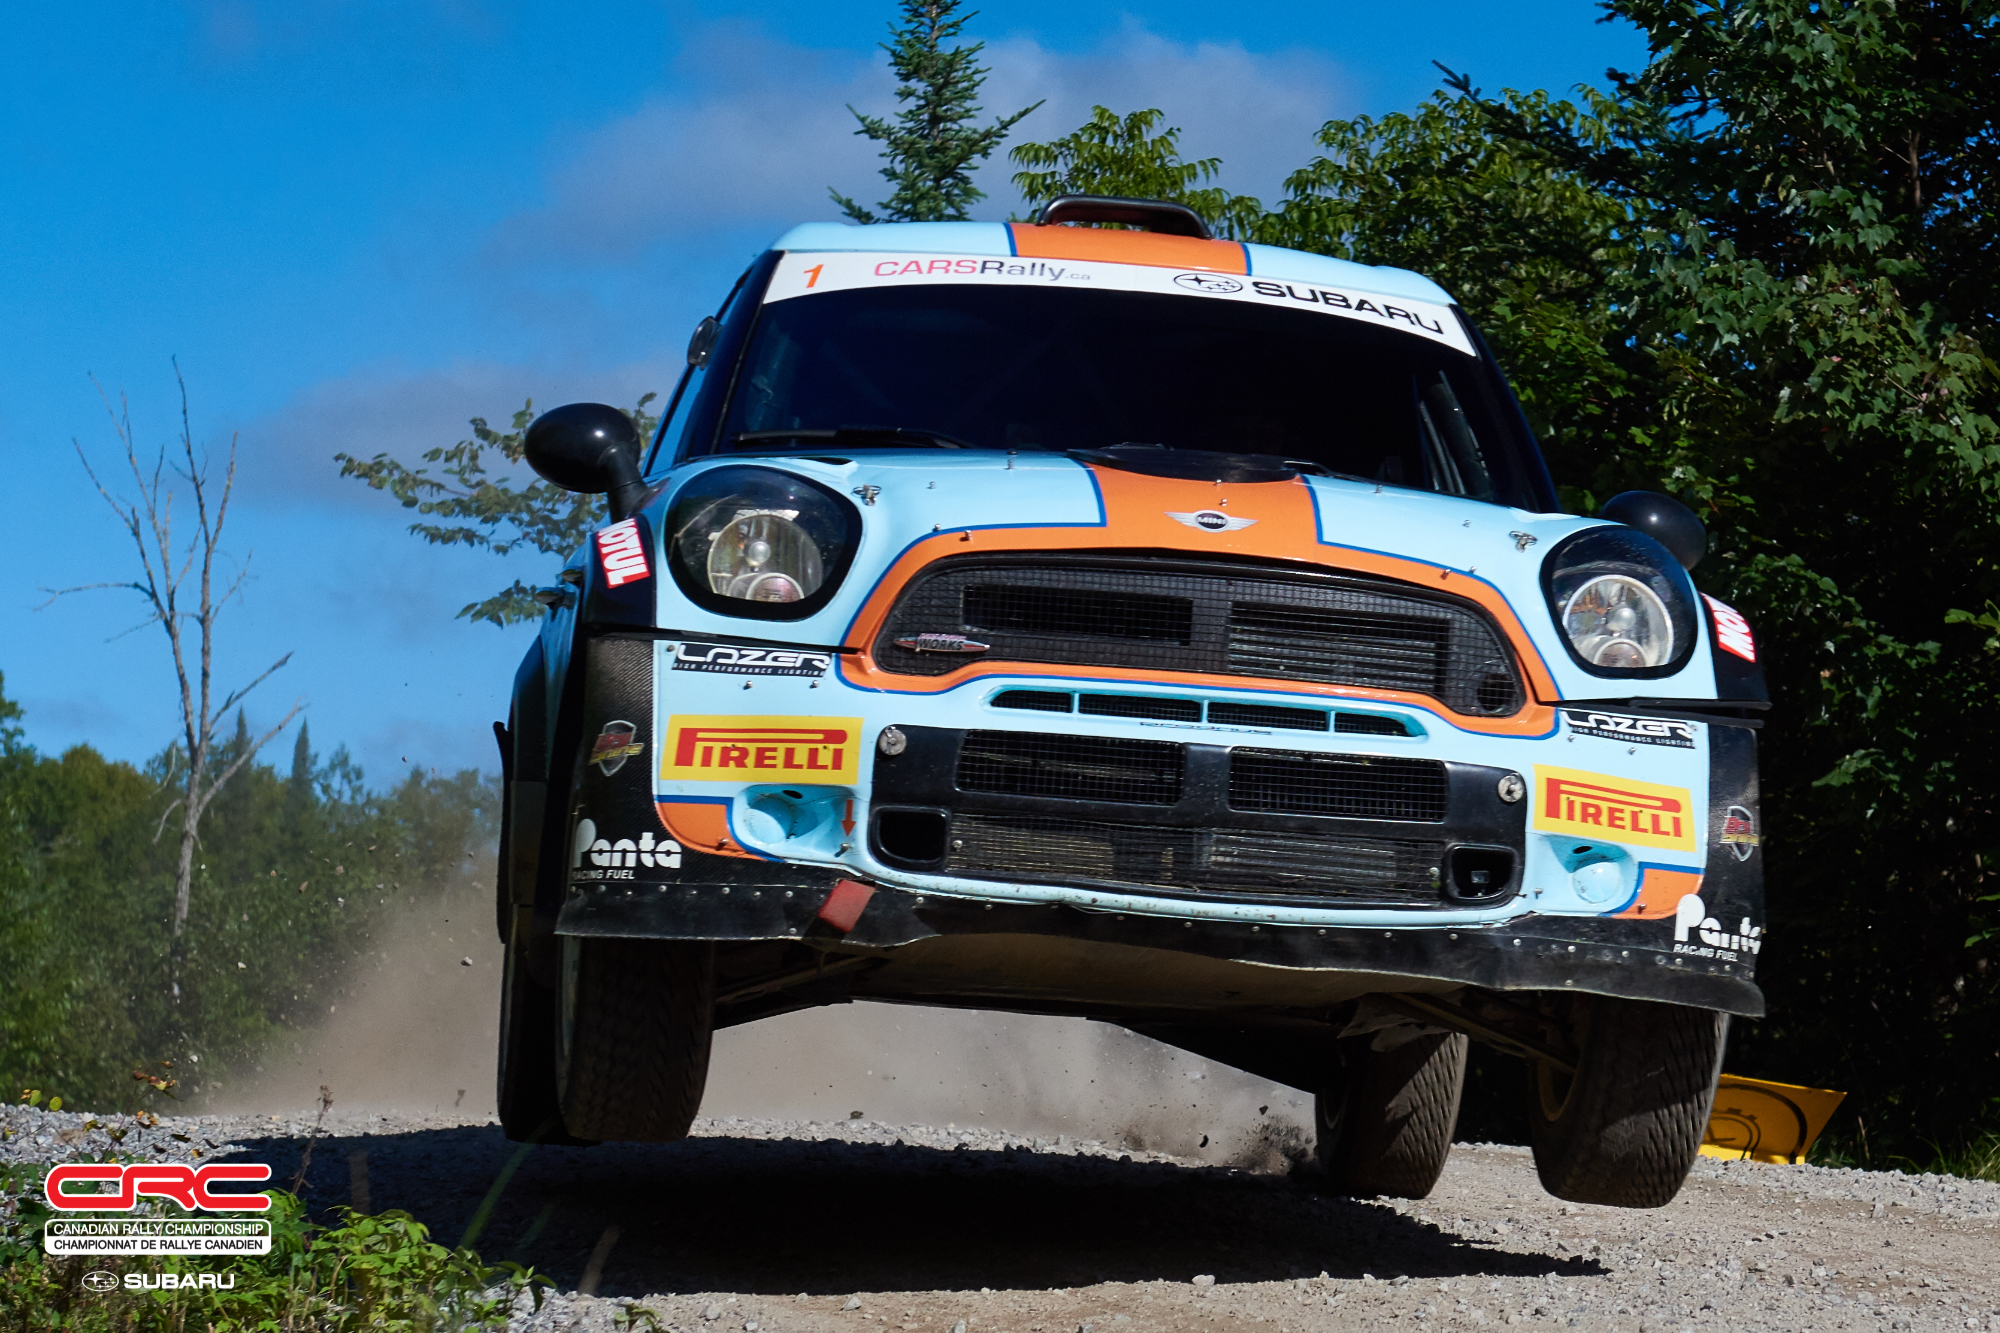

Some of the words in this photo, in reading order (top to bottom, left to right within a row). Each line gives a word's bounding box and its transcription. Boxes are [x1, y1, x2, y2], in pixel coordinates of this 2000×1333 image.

[803, 264, 824, 288] 1
[1252, 281, 1444, 334] SUBARU
[677, 644, 831, 669] LAZER
[919, 638, 965, 651] WORKS
[701, 664, 773, 674] PERFORMANCE
[1560, 711, 1693, 738] LAZER
[674, 728, 848, 770] PIRELLI
[1545, 777, 1682, 838] PIRELLI
[573, 818, 682, 868] Panta
[605, 869, 635, 880] FUEL
[1716, 950, 1738, 961] FUEL
